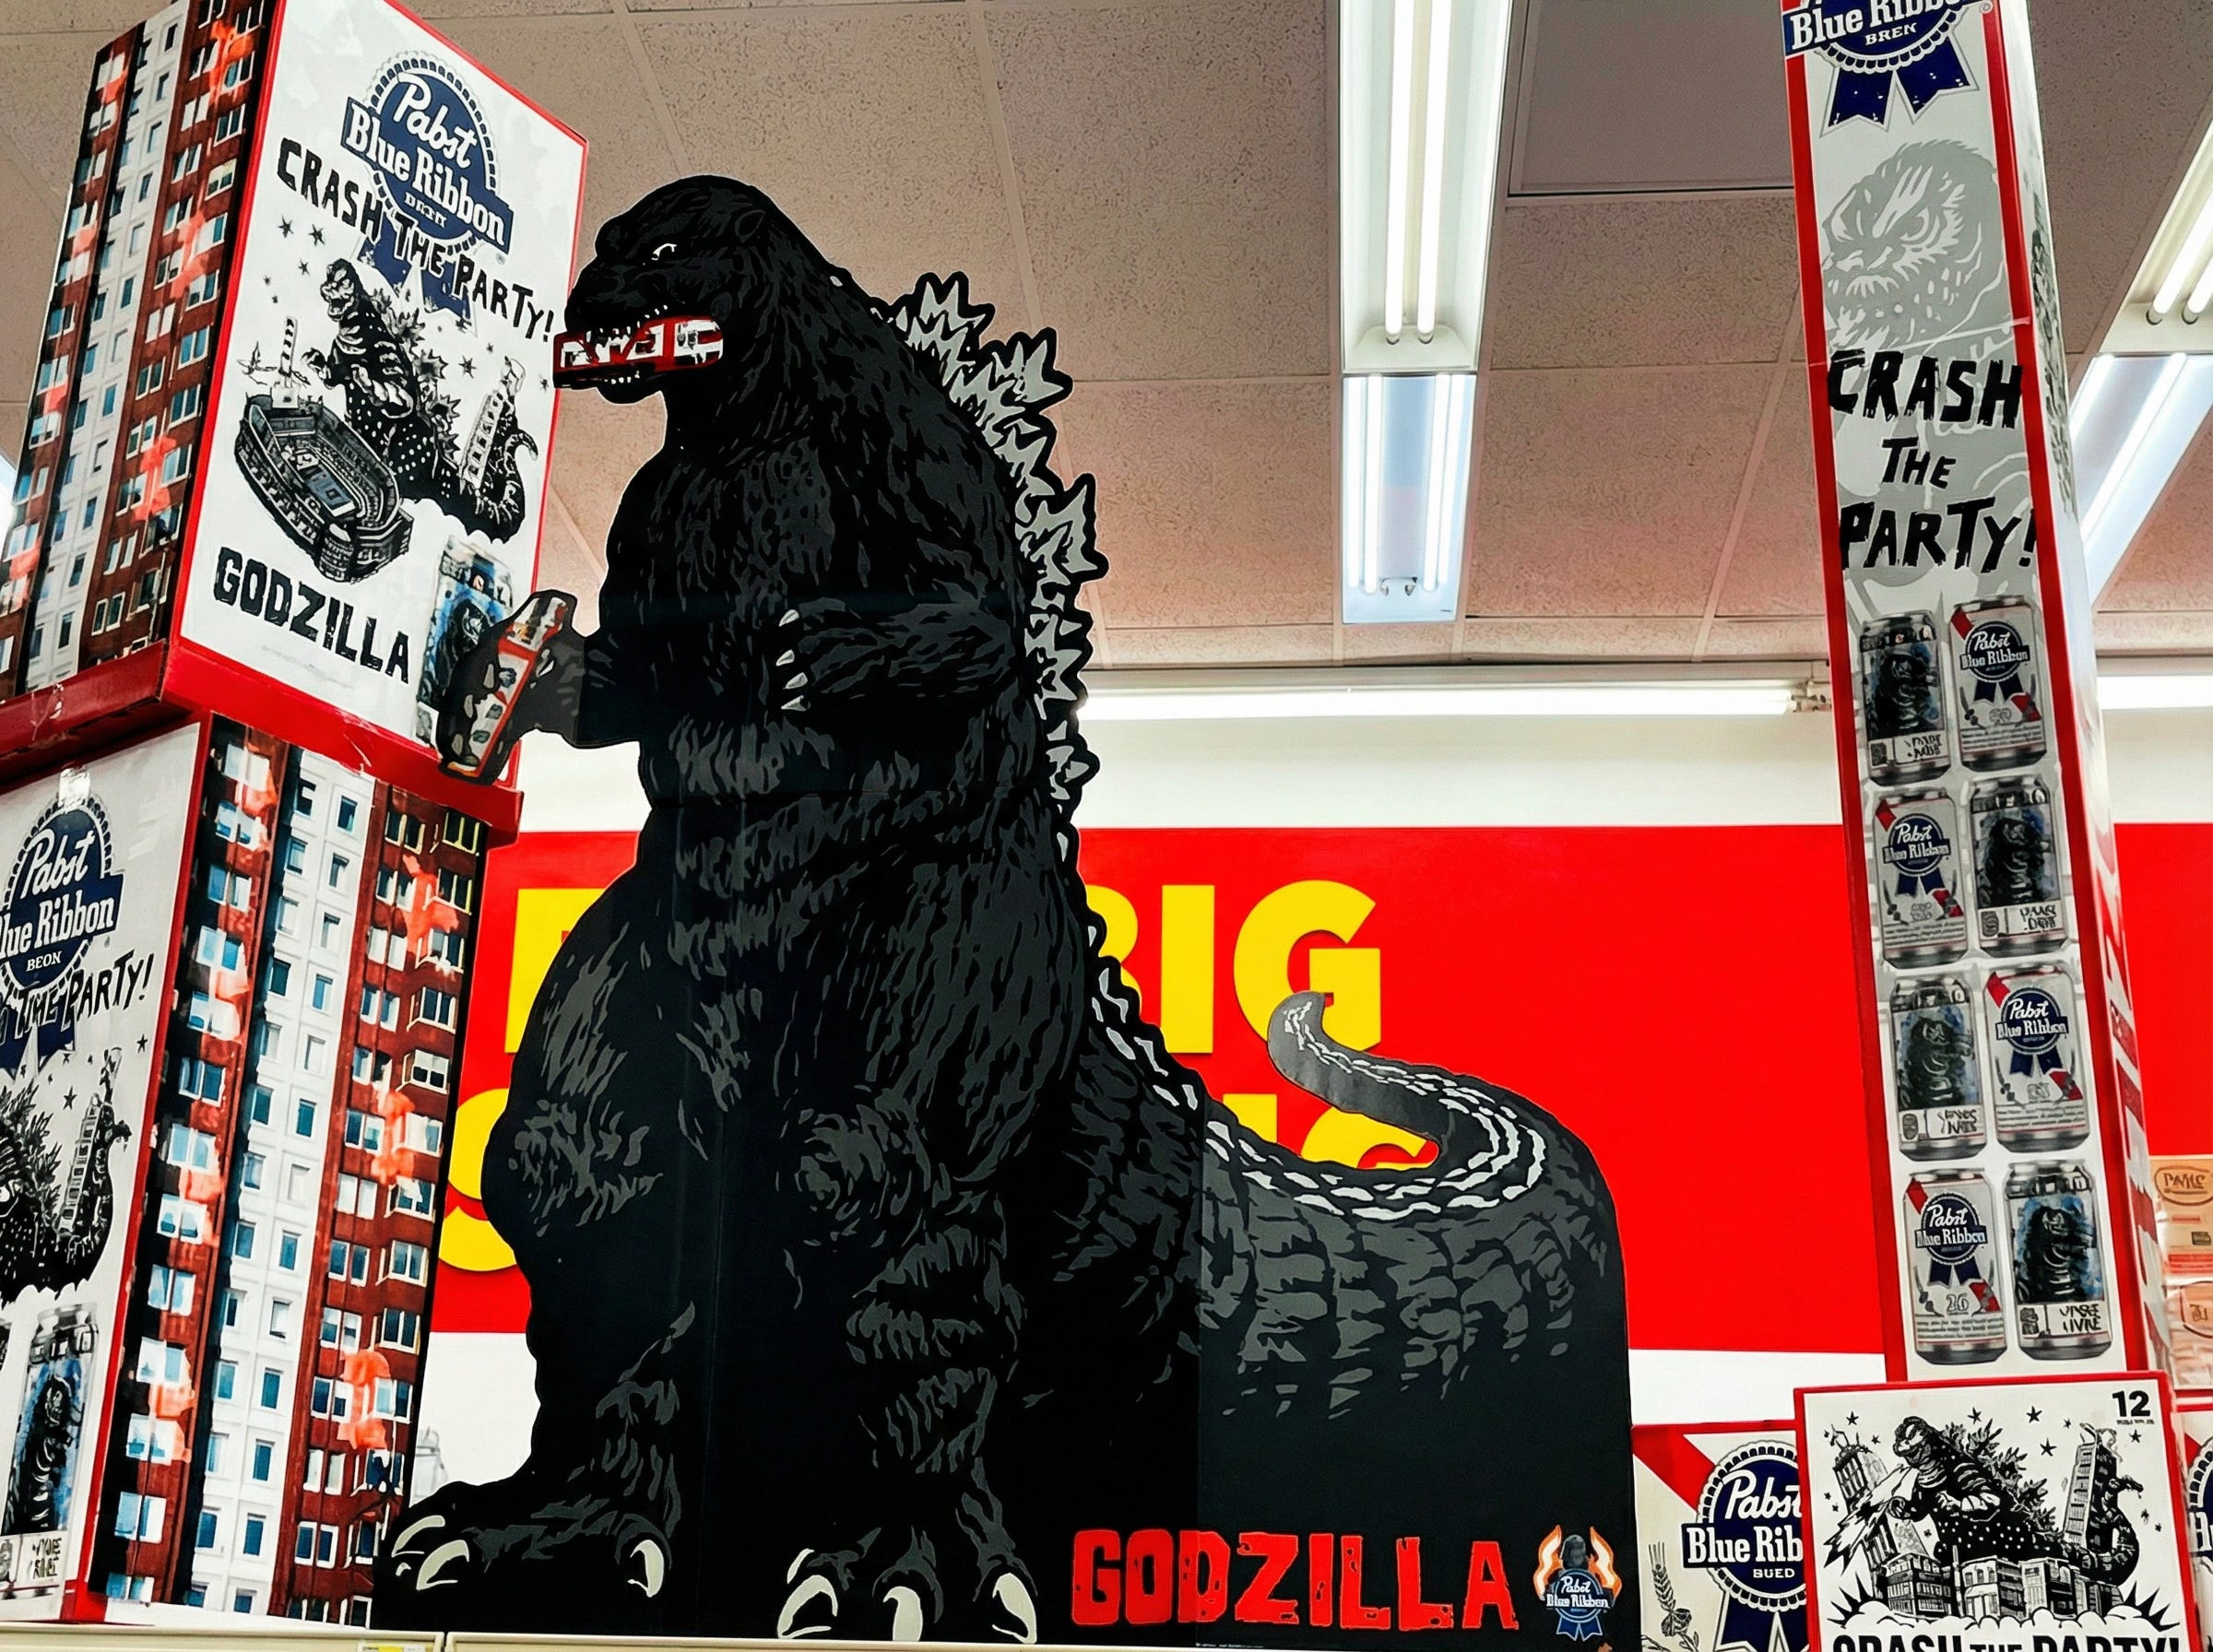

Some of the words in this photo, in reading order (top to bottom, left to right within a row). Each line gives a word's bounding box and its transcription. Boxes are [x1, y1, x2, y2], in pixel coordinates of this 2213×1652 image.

[1789, 7, 1864, 50] Blue
[396, 72, 478, 169] Pabst
[347, 103, 409, 182] Blue
[412, 152, 506, 245] Ribbon
[277, 138, 383, 244] CRASH
[393, 210, 445, 279] THE
[453, 259, 555, 343] PARTY!
[1828, 348, 2023, 430] CRASH
[1882, 436, 1957, 490] THE
[1840, 496, 2038, 573] PARTY!
[213, 547, 410, 684] GODZILLA
[20, 829, 96, 900] Pabst
[0, 911, 32, 961] lue
[33, 890, 115, 950] Ribbon
[61, 948, 155, 1032] PARTY!
[1926, 1204, 1968, 1228] Pabst
[2112, 1389, 2151, 1417] 12
[1722, 1469, 1803, 1519] Pabst
[1071, 1528, 1519, 1631] GODZILLA
[1686, 1527, 1751, 1564] Blue
